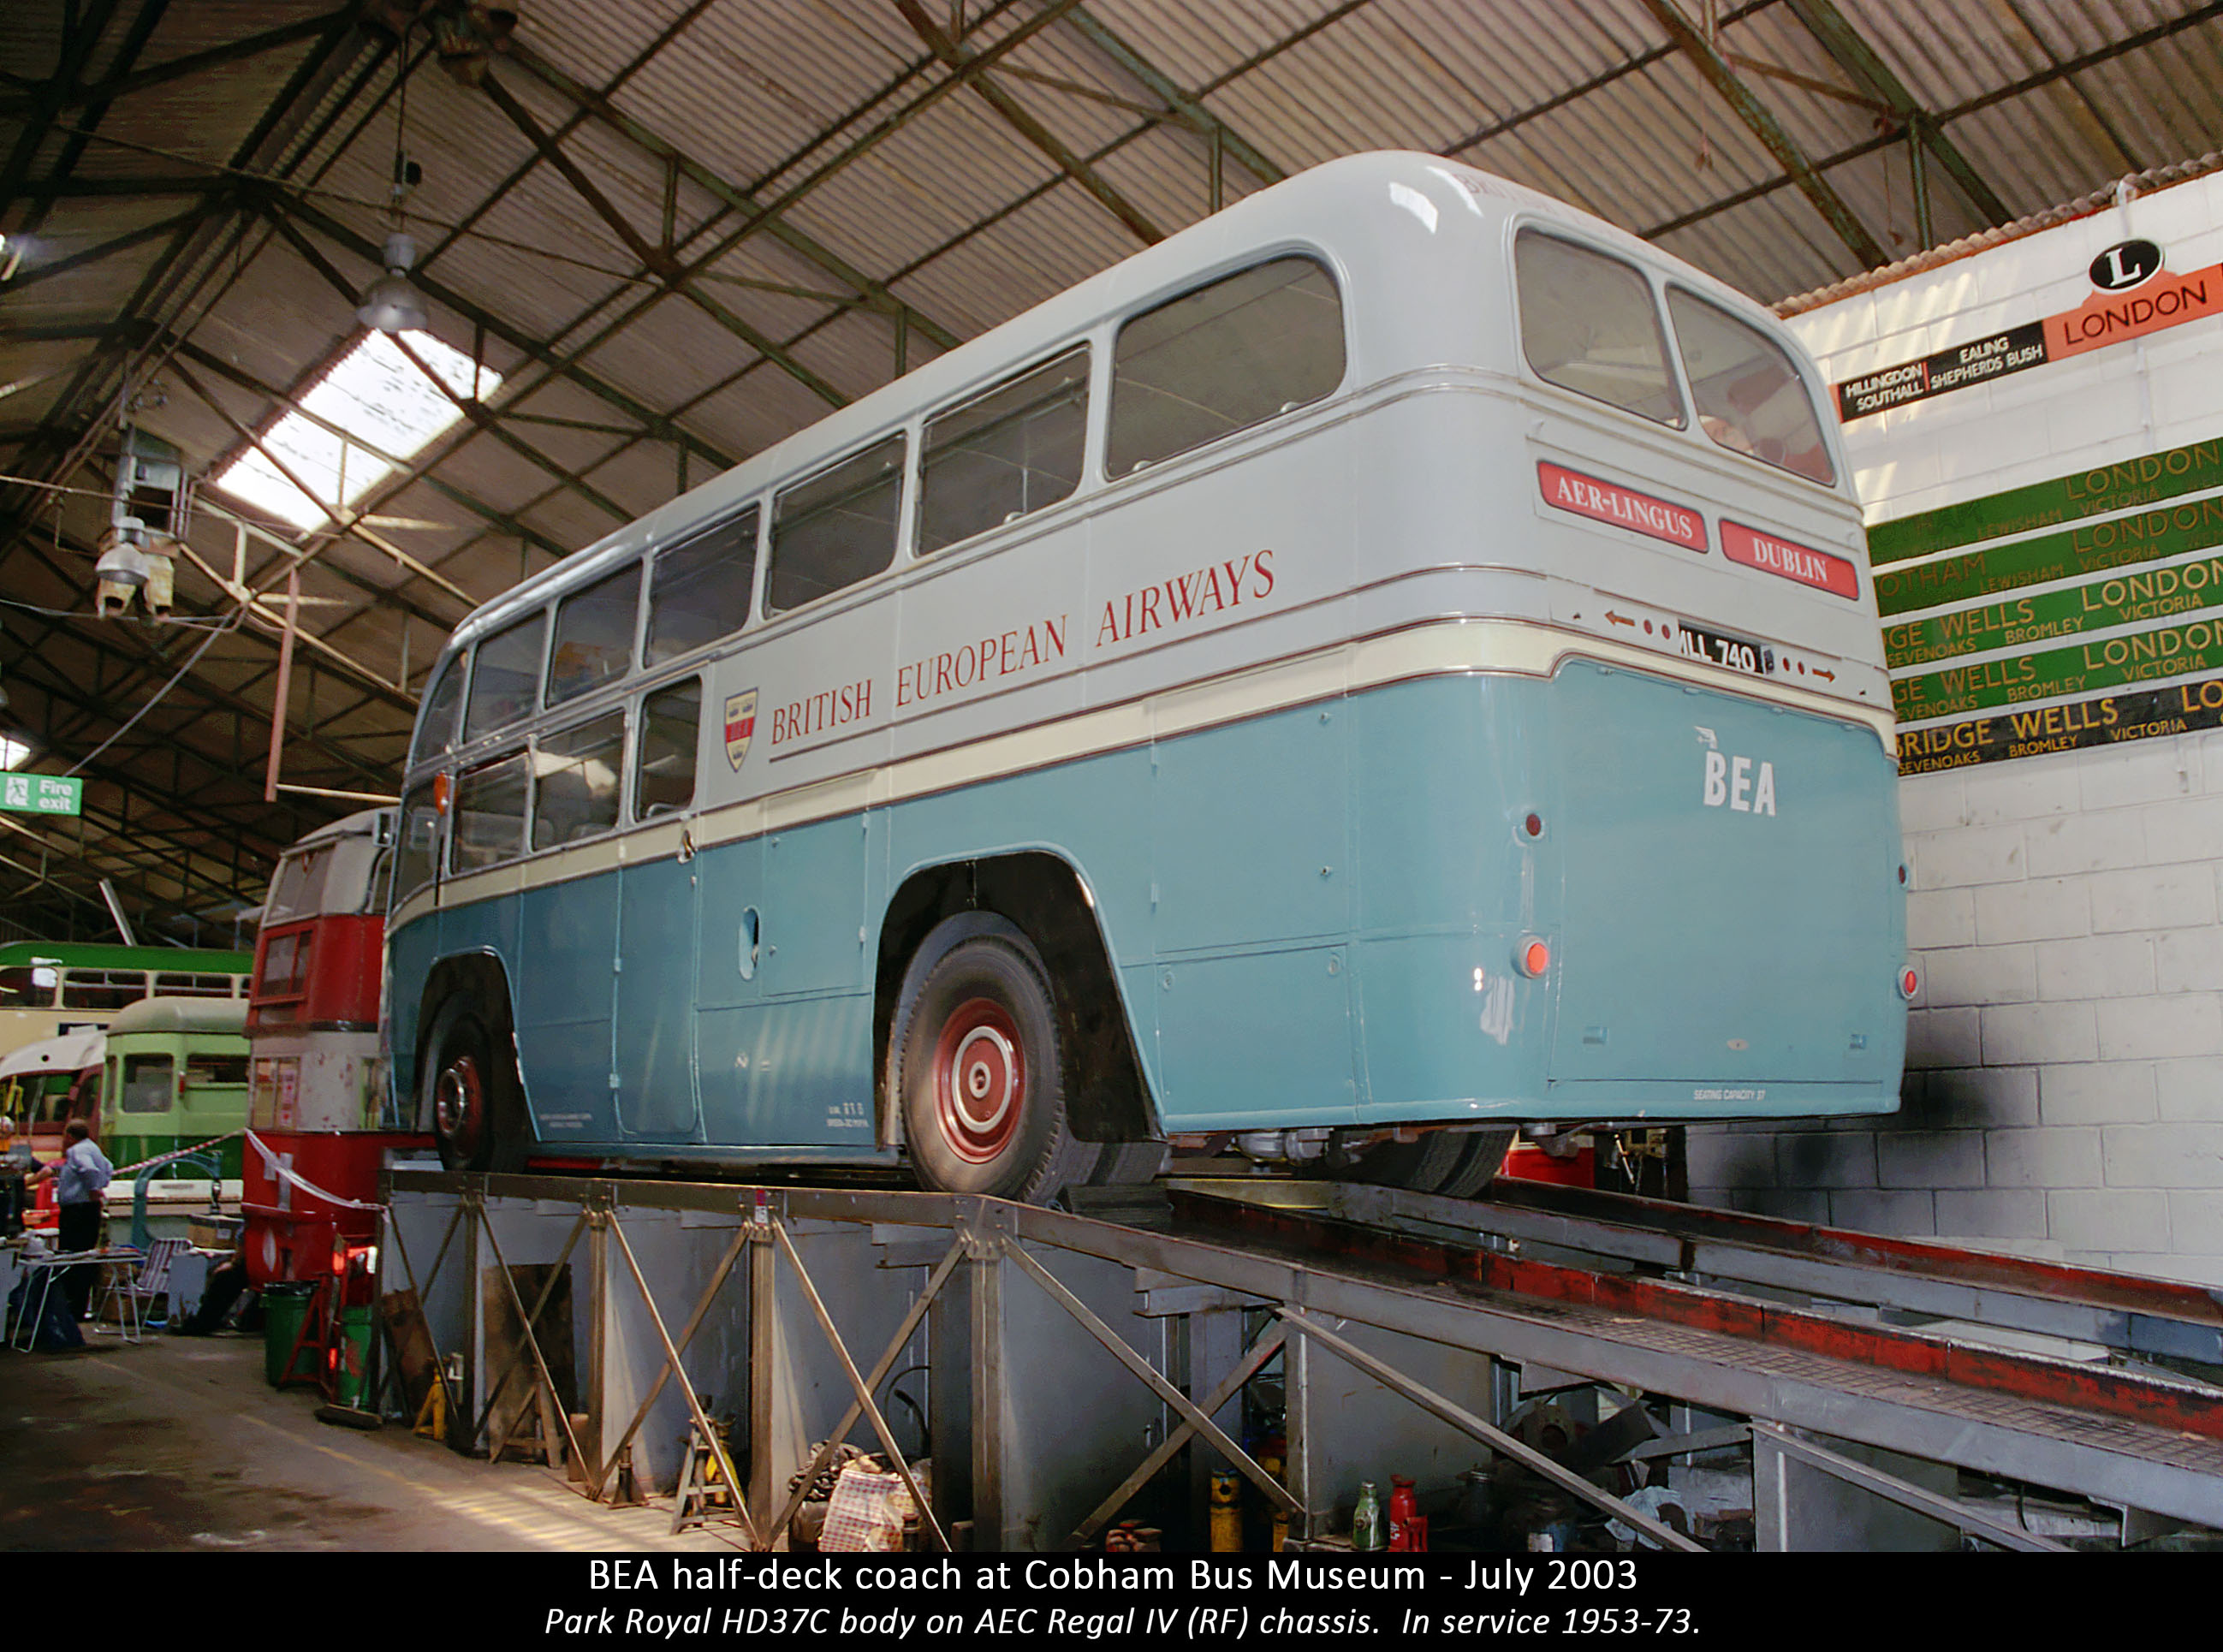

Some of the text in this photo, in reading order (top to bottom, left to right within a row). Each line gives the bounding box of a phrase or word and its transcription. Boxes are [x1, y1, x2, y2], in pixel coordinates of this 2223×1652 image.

[2110, 247, 2141, 287] L
[2065, 281, 2207, 346] LONDON
[1930, 344, 2043, 389] SHEPHERDS BUSH
[1959, 336, 2009, 364] EALING
[1846, 363, 1923, 398] HILLINGDON
[1856, 382, 1923, 412] SOUTHALL
[2065, 440, 2220, 500] LONDON
[1557, 476, 1693, 539] AER-LINGUS
[2079, 485, 2160, 515] VICTORIA
[2072, 497, 2223, 555] LONDON
[1752, 538, 1828, 582] DUBLIN
[1980, 544, 2160, 593] LEWISHAM VICTORIA
[1887, 593, 2204, 667] SEVENOAKS BROMLEY VICTORIA
[1940, 598, 2035, 639] WELLS
[771, 550, 1275, 746] BRITISH EUROPEAN AIRWAYS
[1715, 639, 1756, 673] 740
[1939, 656, 2036, 695] WELLS
[2006, 674, 2086, 703] BROMLEY
[2121, 654, 2207, 681] VICTORIA
[2012, 698, 2119, 740] WELLS
[2181, 680, 2223, 712] LO
[1899, 718, 2188, 775] SEVENOAKS BROMLEY VICTORIA
[39, 779, 72, 796] Fire
[39, 797, 71, 811] exit
[1703, 751, 1776, 817] BEA
[1694, 1089, 1722, 1101] SEATING
[1723, 1089, 1755, 1101] CAPACITY
